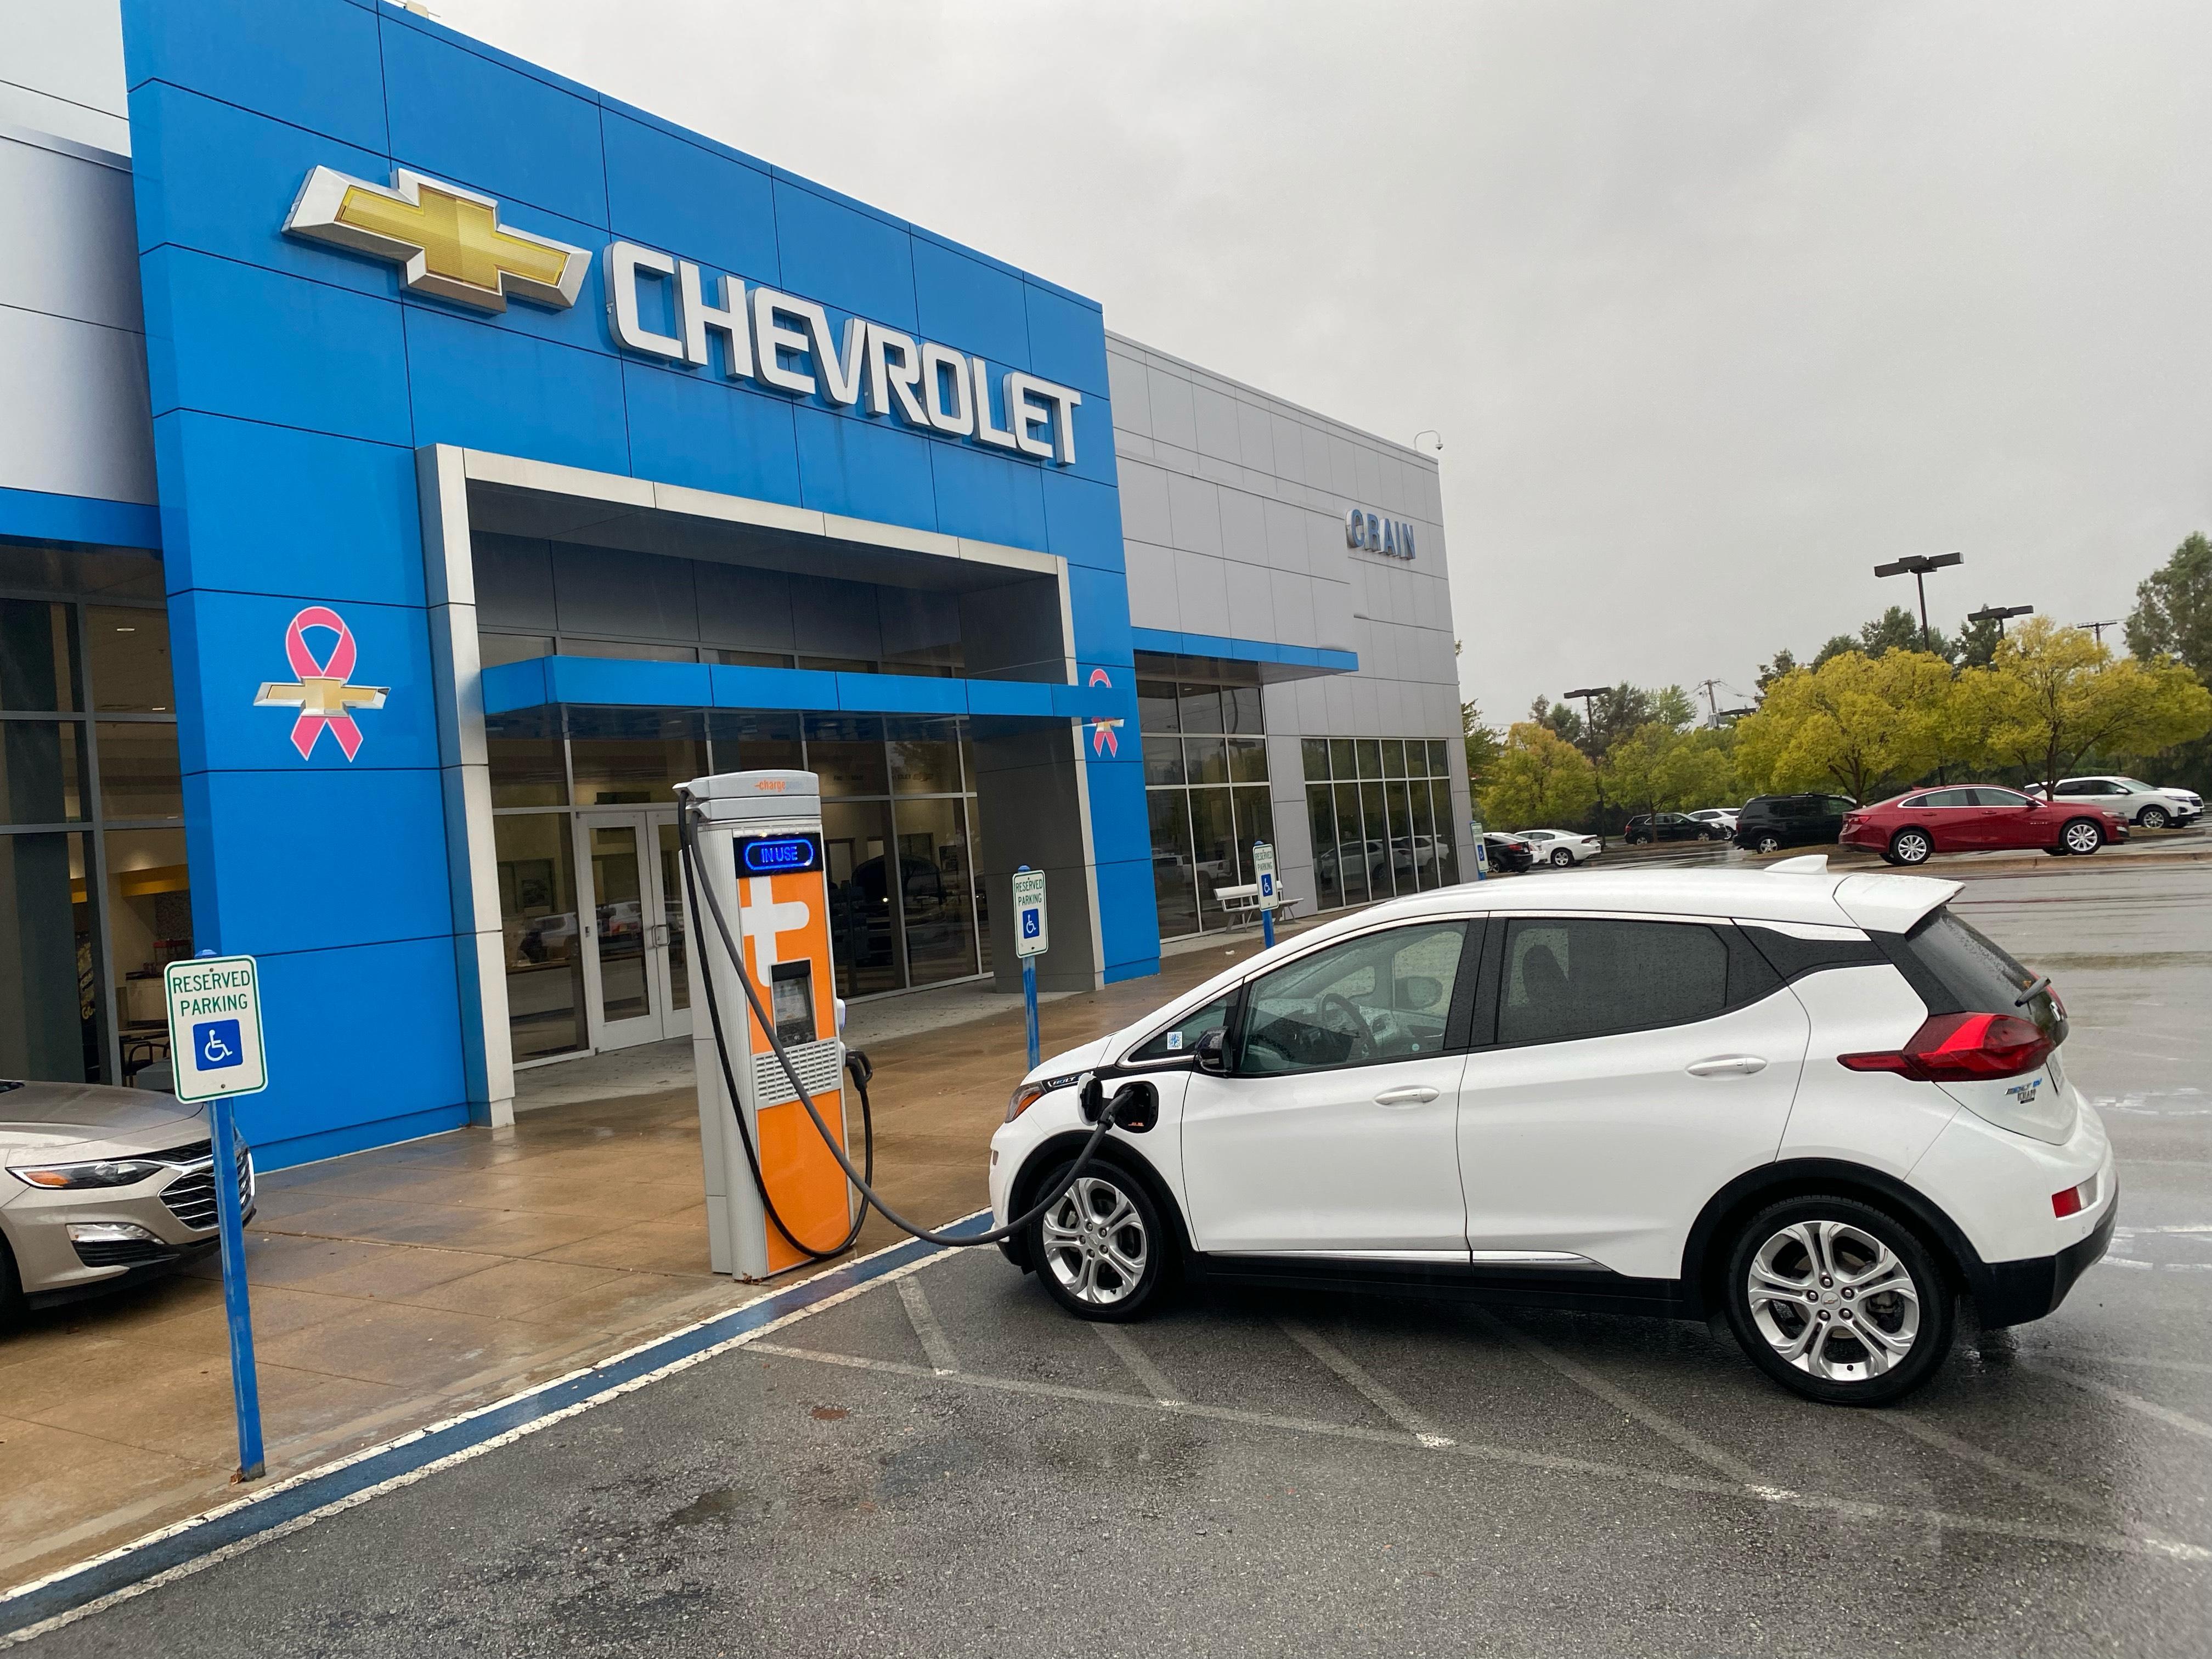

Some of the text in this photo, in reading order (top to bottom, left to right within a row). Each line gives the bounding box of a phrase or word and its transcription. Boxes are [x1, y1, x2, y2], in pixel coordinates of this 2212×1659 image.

[603, 241, 1082, 466] CHEVROLET
[1346, 509, 1415, 560] CRAIN
[761, 847, 798, 863] IN USE
[1015, 879, 1043, 893] RESERVED
[1018, 893, 1042, 906] PARKING
[172, 970, 250, 994] RESERVED
[180, 994, 247, 1017] PARKING
